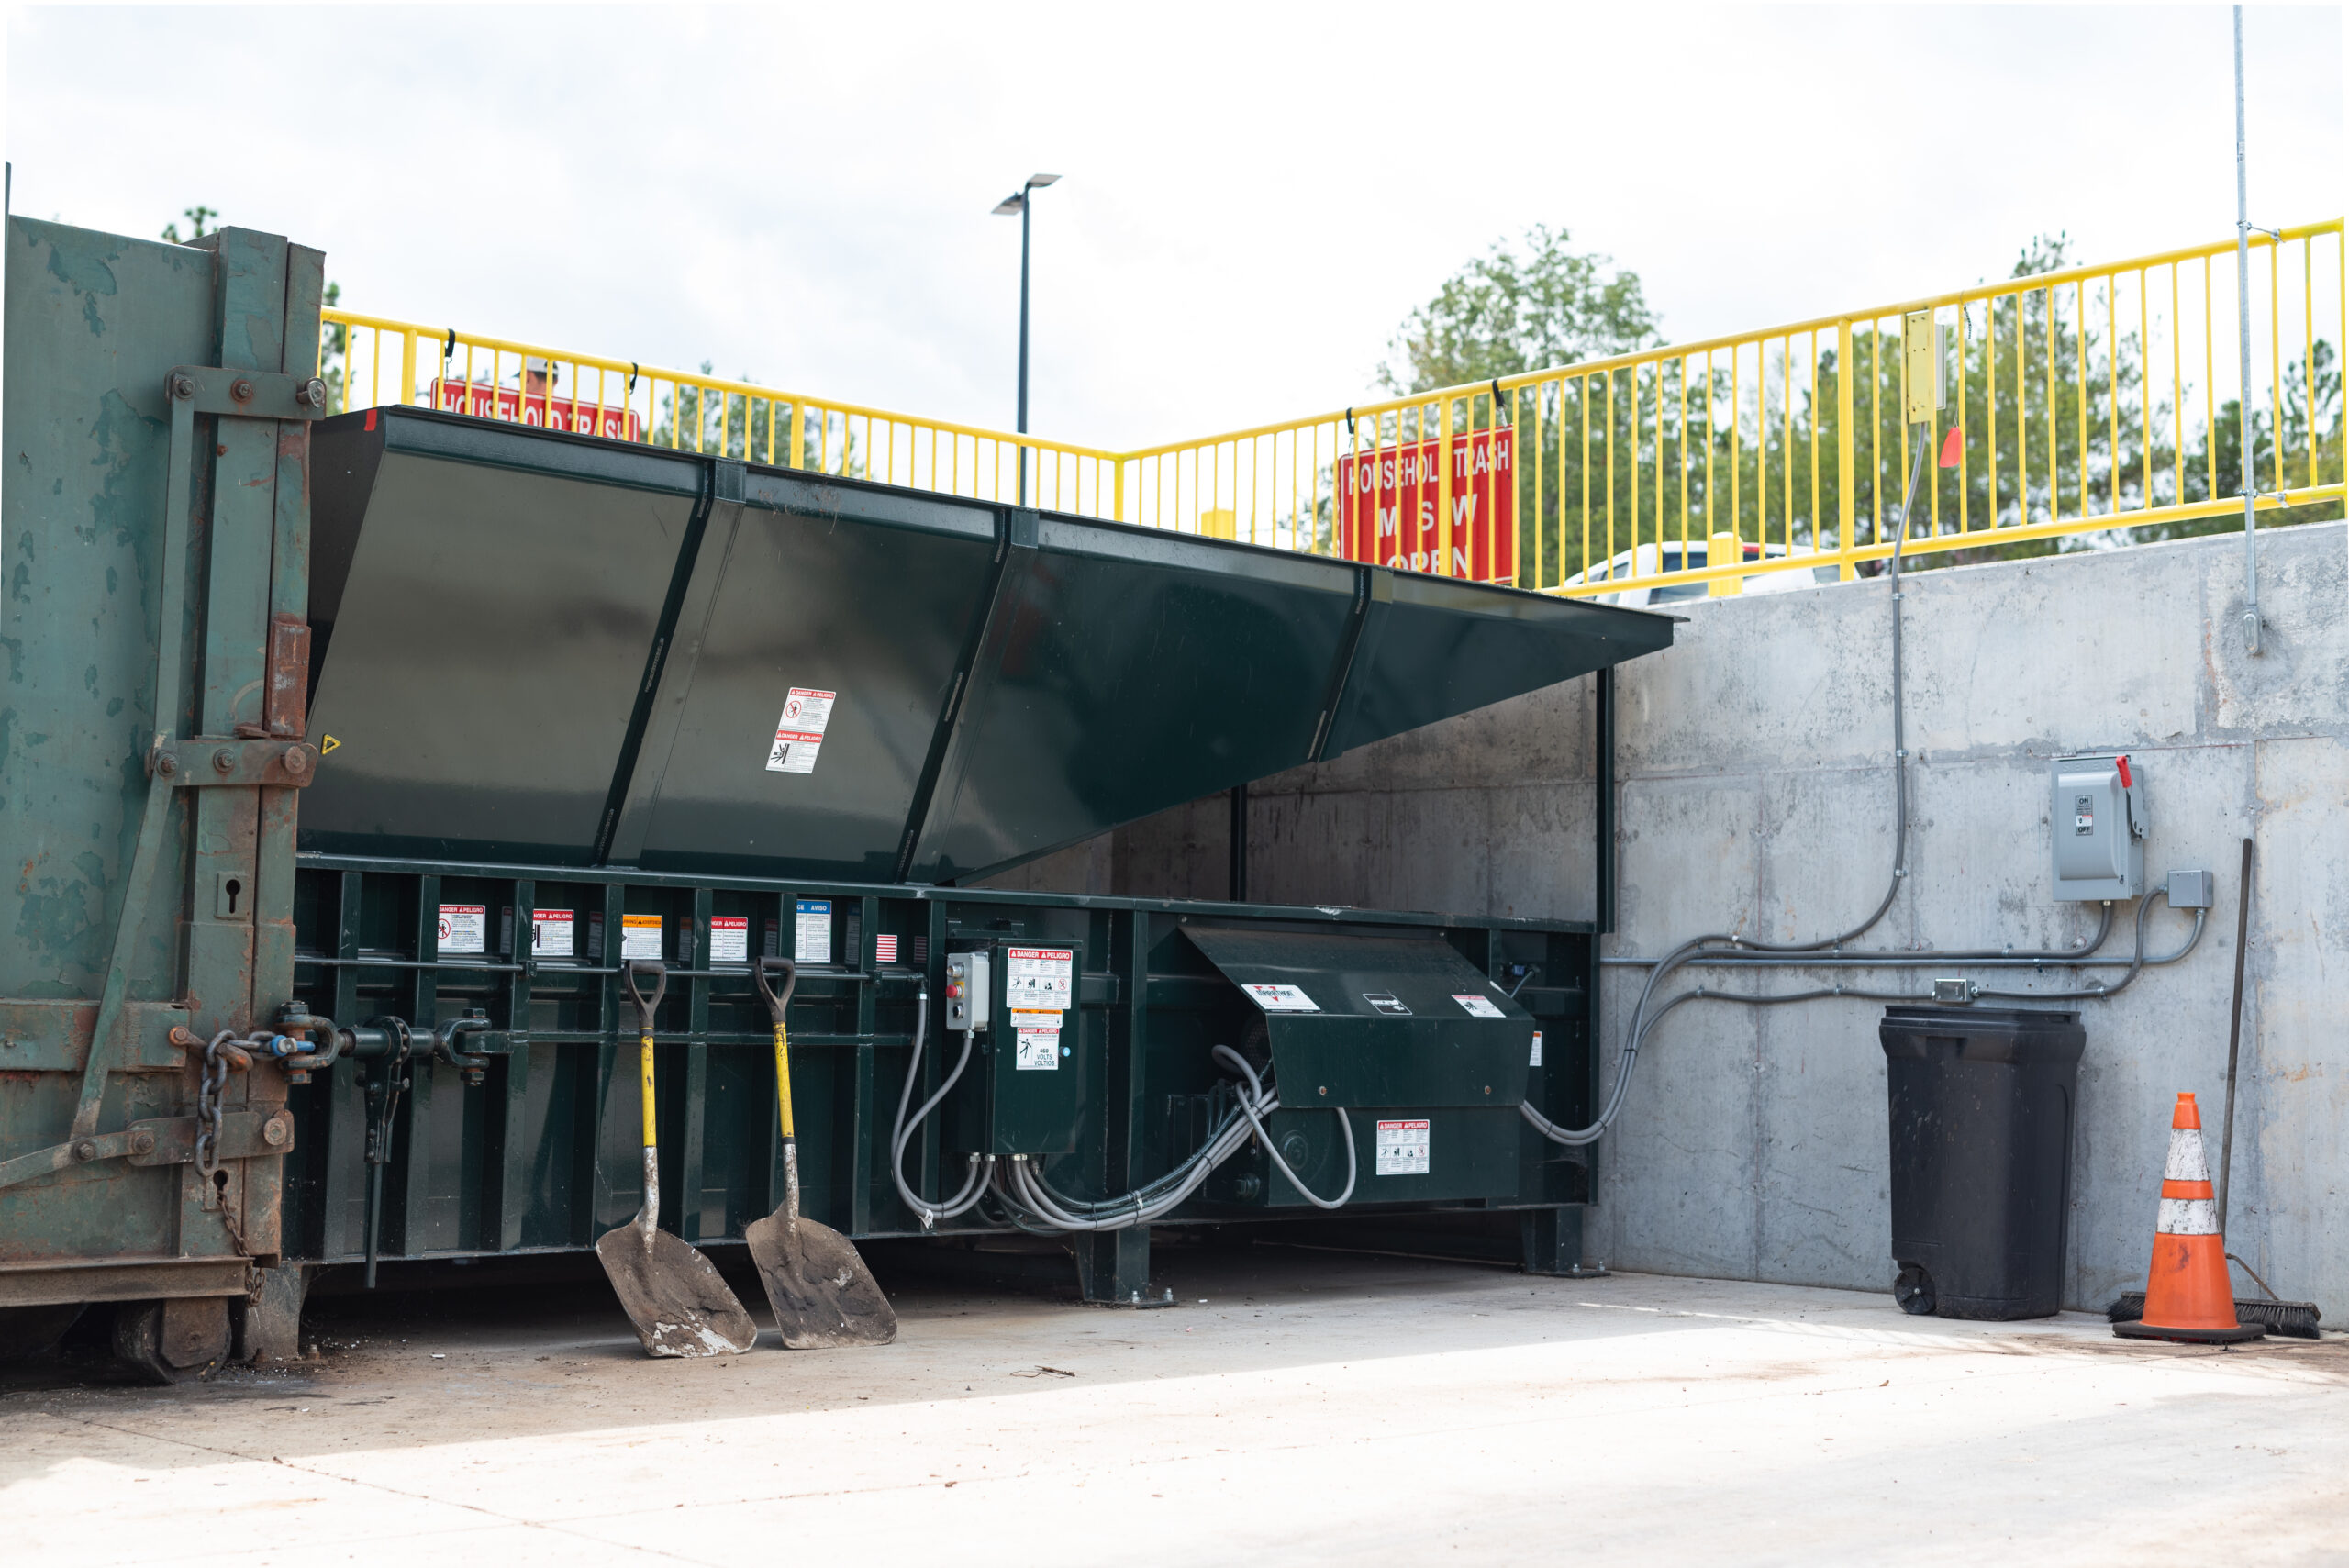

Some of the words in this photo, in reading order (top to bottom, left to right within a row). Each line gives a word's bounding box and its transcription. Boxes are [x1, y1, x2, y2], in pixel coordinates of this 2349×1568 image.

[1348, 453, 1439, 495] HOUSHOL
[1379, 506, 1397, 539] M
[1418, 500, 1435, 532] S
[1452, 493, 1478, 527] W
